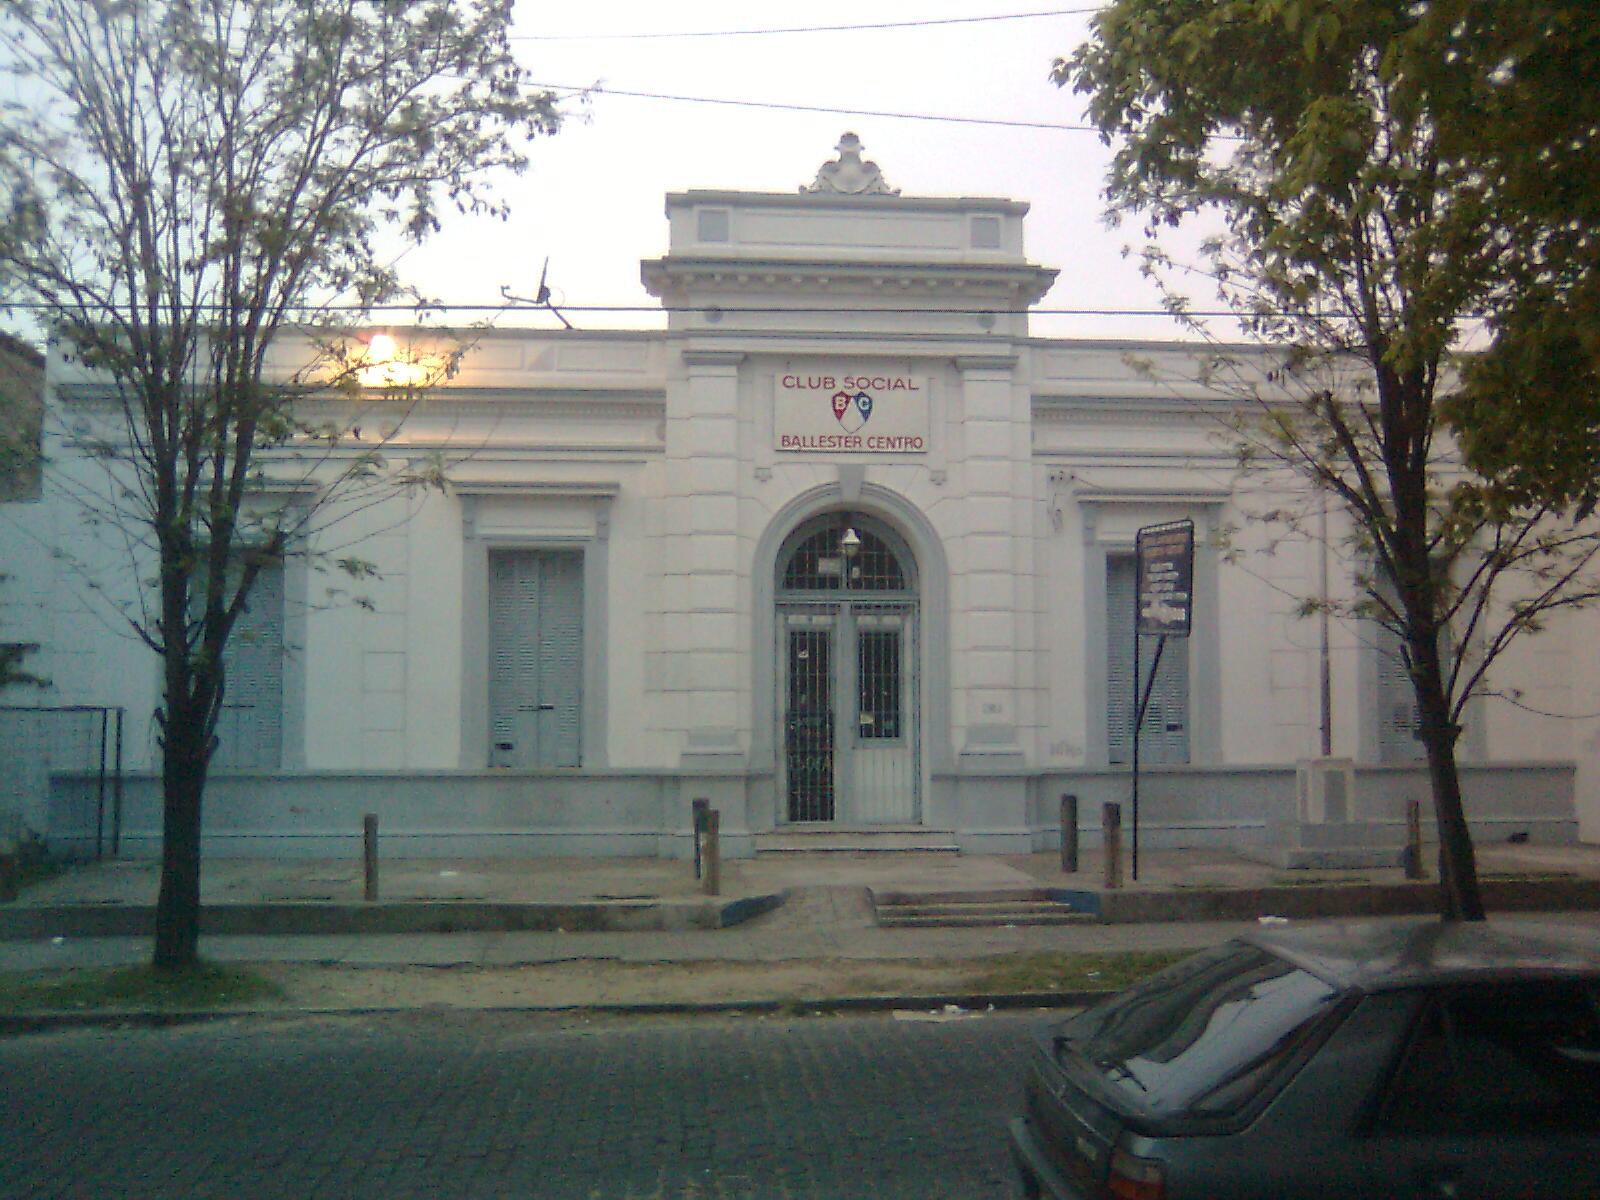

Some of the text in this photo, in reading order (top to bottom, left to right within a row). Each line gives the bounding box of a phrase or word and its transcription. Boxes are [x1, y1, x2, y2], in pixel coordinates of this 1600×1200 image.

[782, 375, 920, 391] CLUB SOCIAL
[837, 396, 847, 410] B
[781, 435, 923, 449] BALLESTER CENTRO
